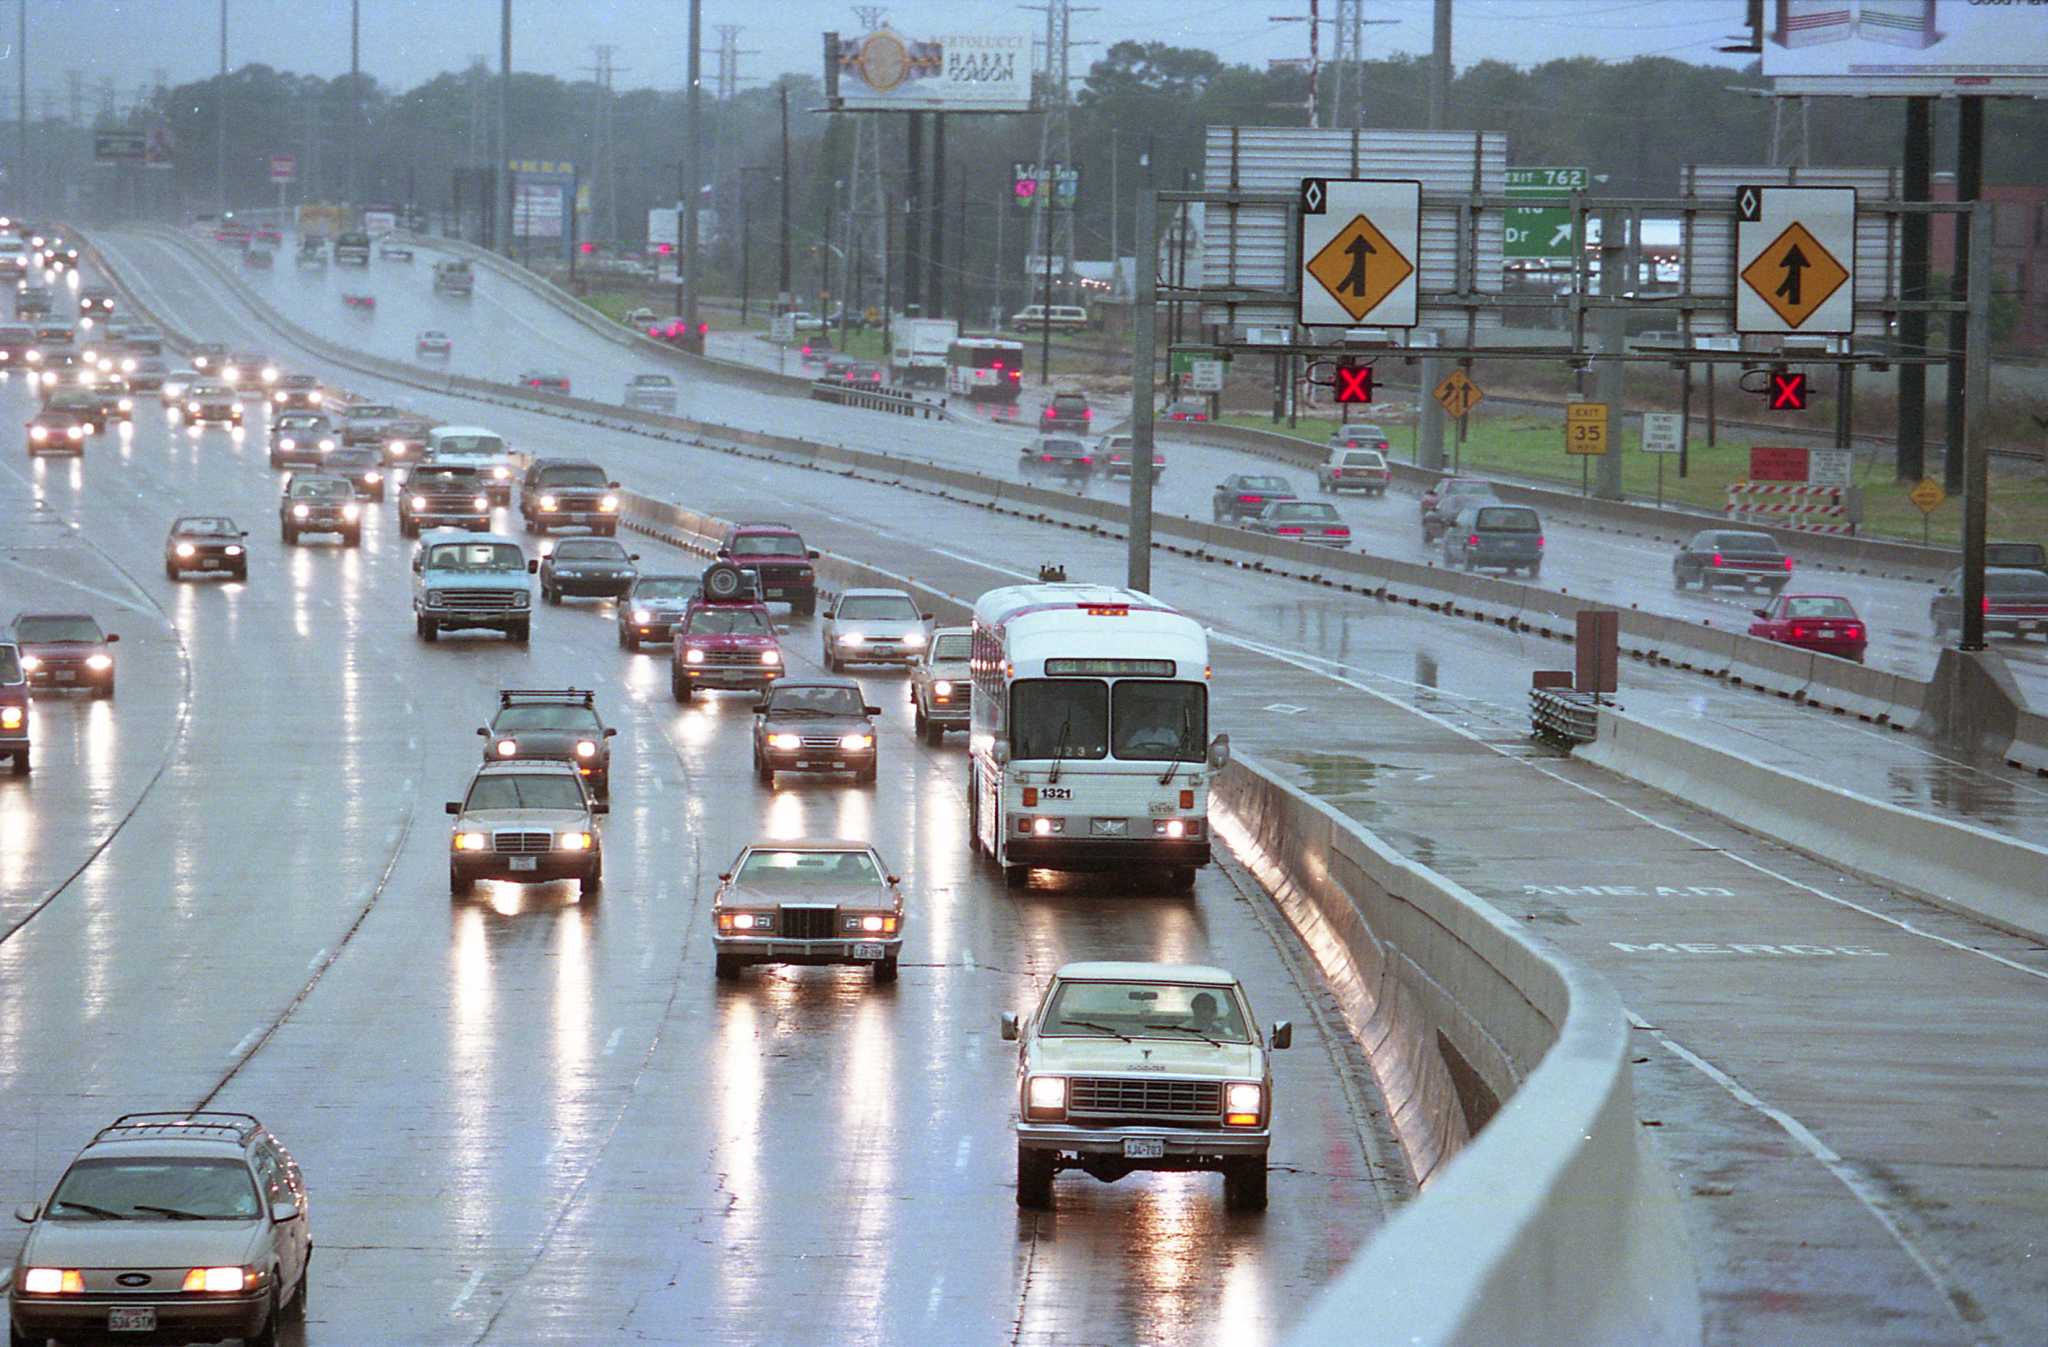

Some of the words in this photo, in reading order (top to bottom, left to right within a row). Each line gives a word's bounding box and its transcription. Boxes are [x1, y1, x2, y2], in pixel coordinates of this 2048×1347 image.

[950, 52, 1015, 67] HARRY
[949, 66, 1015, 82] GORDON
[1544, 170, 1582, 186] 762
[1505, 227, 1529, 243] Dr
[1574, 425, 1601, 441] 35
[1040, 788, 1072, 799] 1321
[1522, 884, 1737, 897] AHEAD
[1609, 941, 1890, 957] MERGE
